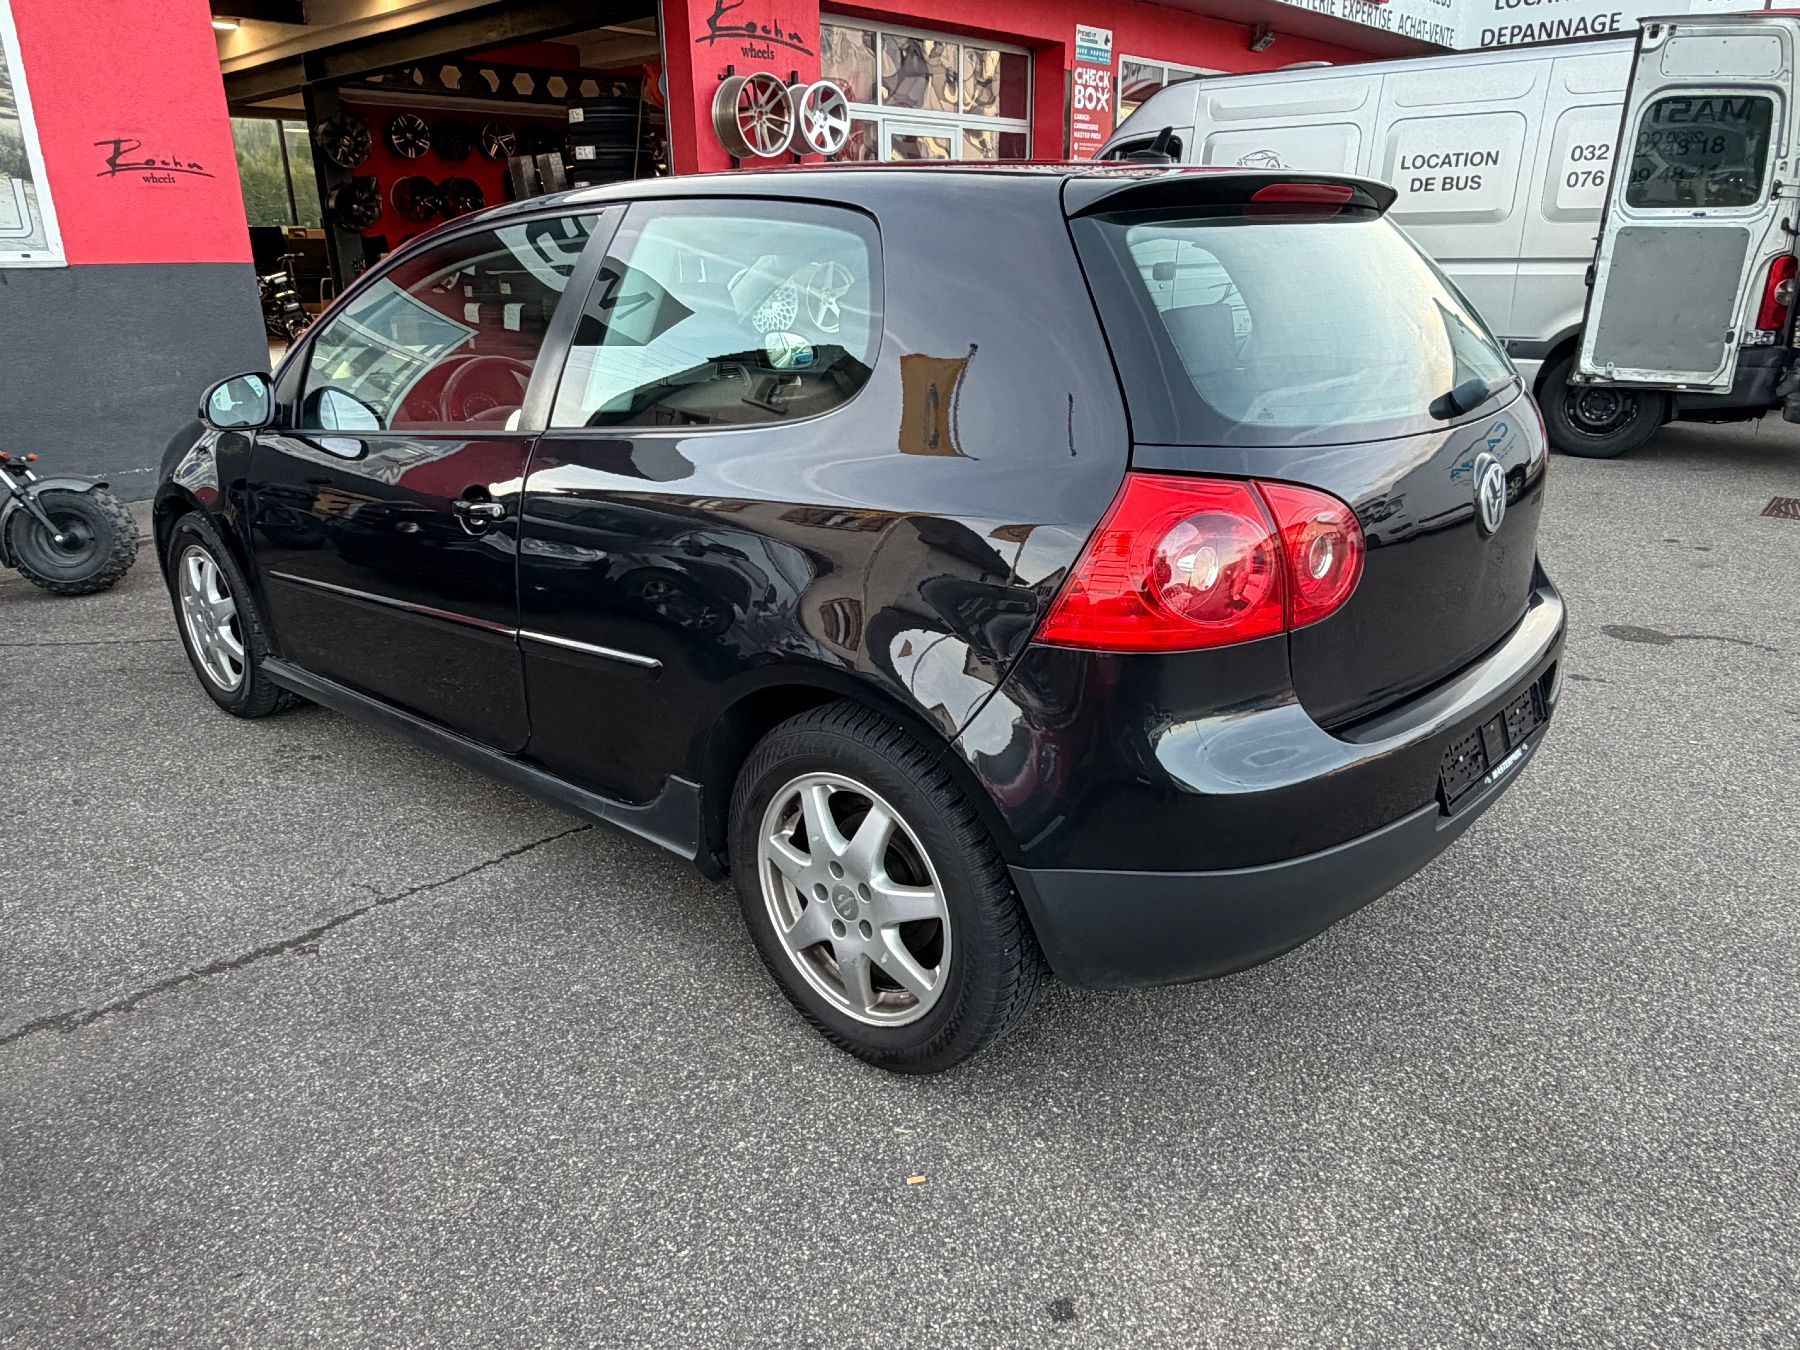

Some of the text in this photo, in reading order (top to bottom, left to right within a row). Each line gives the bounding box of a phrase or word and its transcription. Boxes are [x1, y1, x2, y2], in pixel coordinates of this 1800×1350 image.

[1342, 4, 1393, 30] EXPERTISE
[1398, 14, 1455, 47] ACHAT-VENTE
[1480, 12, 1623, 47] DEPANNAGE
[741, 42, 775, 60] wheels
[1074, 67, 1111, 88] CHECK
[1074, 85, 1110, 112] BOX
[1401, 150, 1500, 170] LOCATION
[1570, 143, 1610, 162] 032
[142, 173, 176, 184] wheels
[1409, 175, 1482, 192] DE BUS
[1566, 170, 1605, 188] 076
